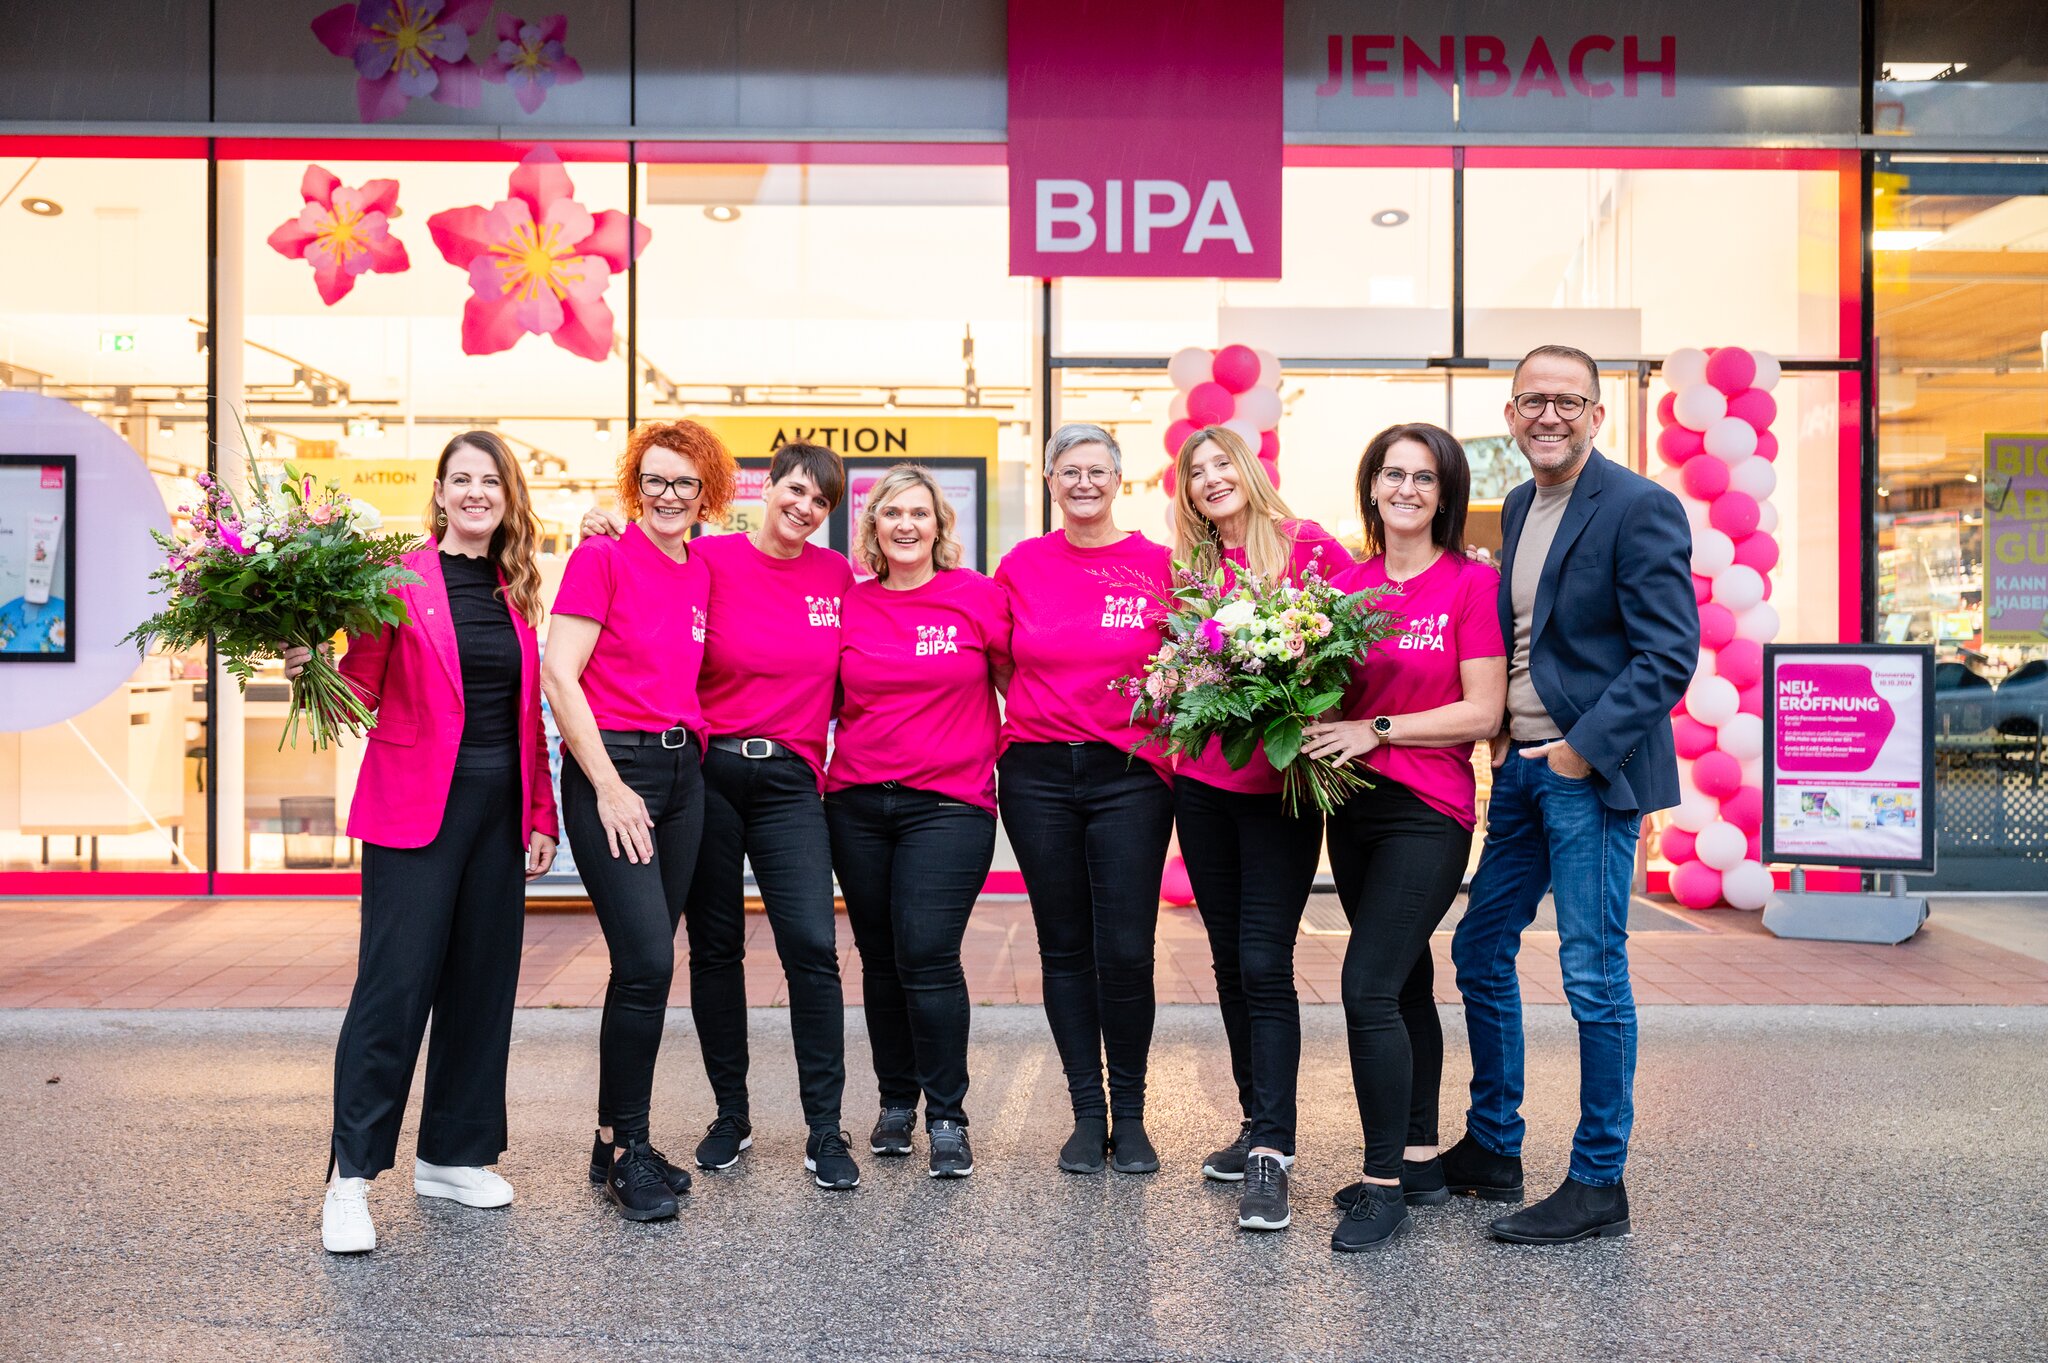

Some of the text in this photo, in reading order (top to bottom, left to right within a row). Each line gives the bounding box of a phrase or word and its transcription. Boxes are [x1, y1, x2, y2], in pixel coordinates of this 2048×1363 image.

[1315, 35, 1676, 97] JENBACH
[1036, 180, 1254, 254] BIPA
[770, 428, 907, 452] AKTION
[354, 471, 416, 485] AKTION
[1995, 575, 2047, 592] KANN
[808, 613, 842, 628] BIPA
[1101, 613, 1145, 629] BIPA
[915, 641, 958, 656] BIPA
[1398, 634, 1445, 652] BIPA
[1779, 680, 1819, 695] NEU-
[1779, 694, 1880, 712] ERÖFFNUNG
